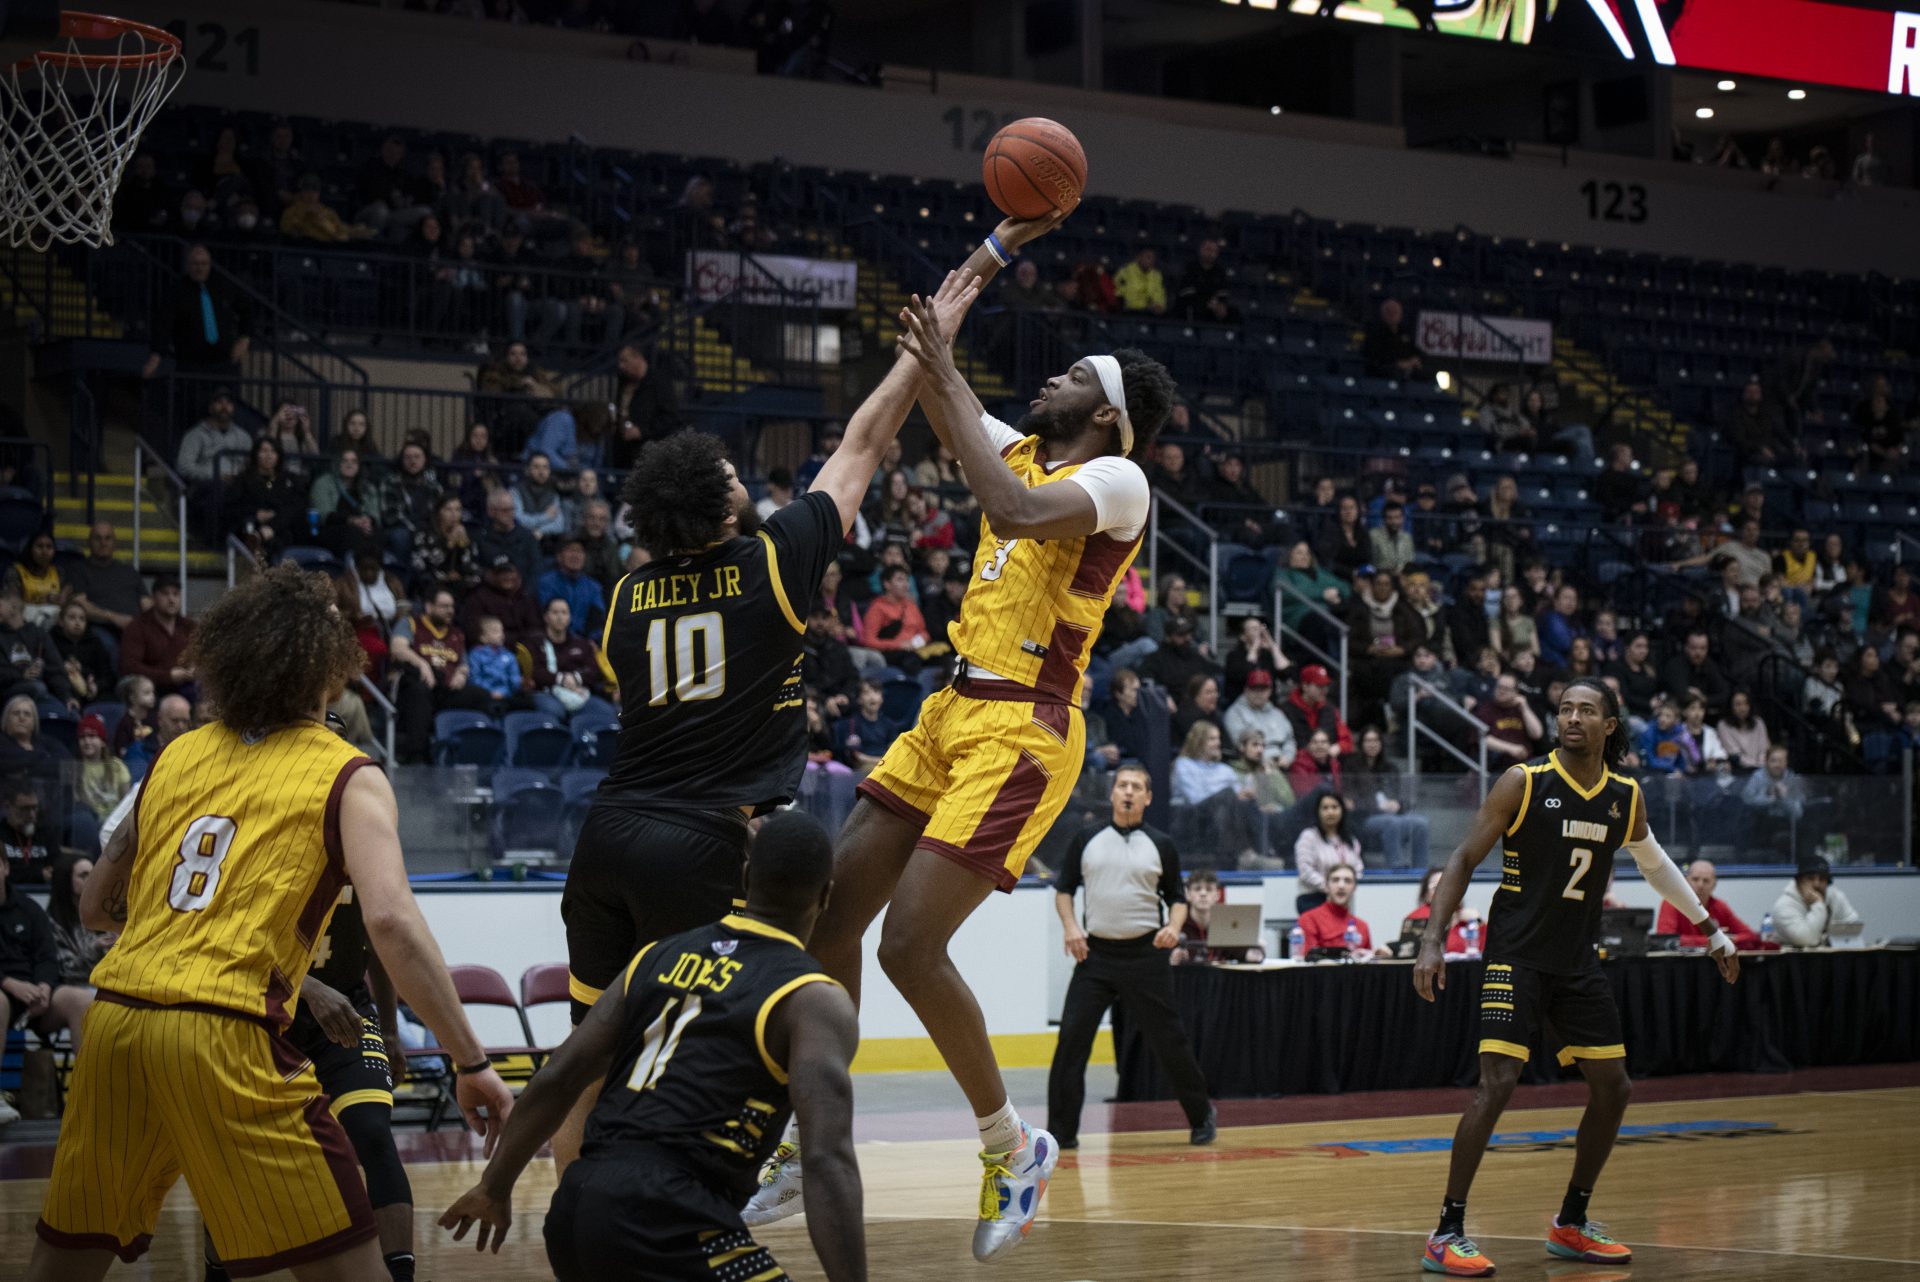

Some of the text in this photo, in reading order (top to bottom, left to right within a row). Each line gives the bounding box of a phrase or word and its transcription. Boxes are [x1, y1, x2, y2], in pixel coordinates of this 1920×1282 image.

[943, 106, 1016, 151] 12
[1580, 180, 1648, 223] 123
[980, 538, 1019, 581] 3
[630, 565, 742, 613] HALEY JR
[645, 611, 726, 707] 10
[1562, 819, 1609, 844] LONDON
[167, 814, 238, 913] 8
[1561, 847, 1593, 902] 2
[625, 994, 703, 1093] 11
